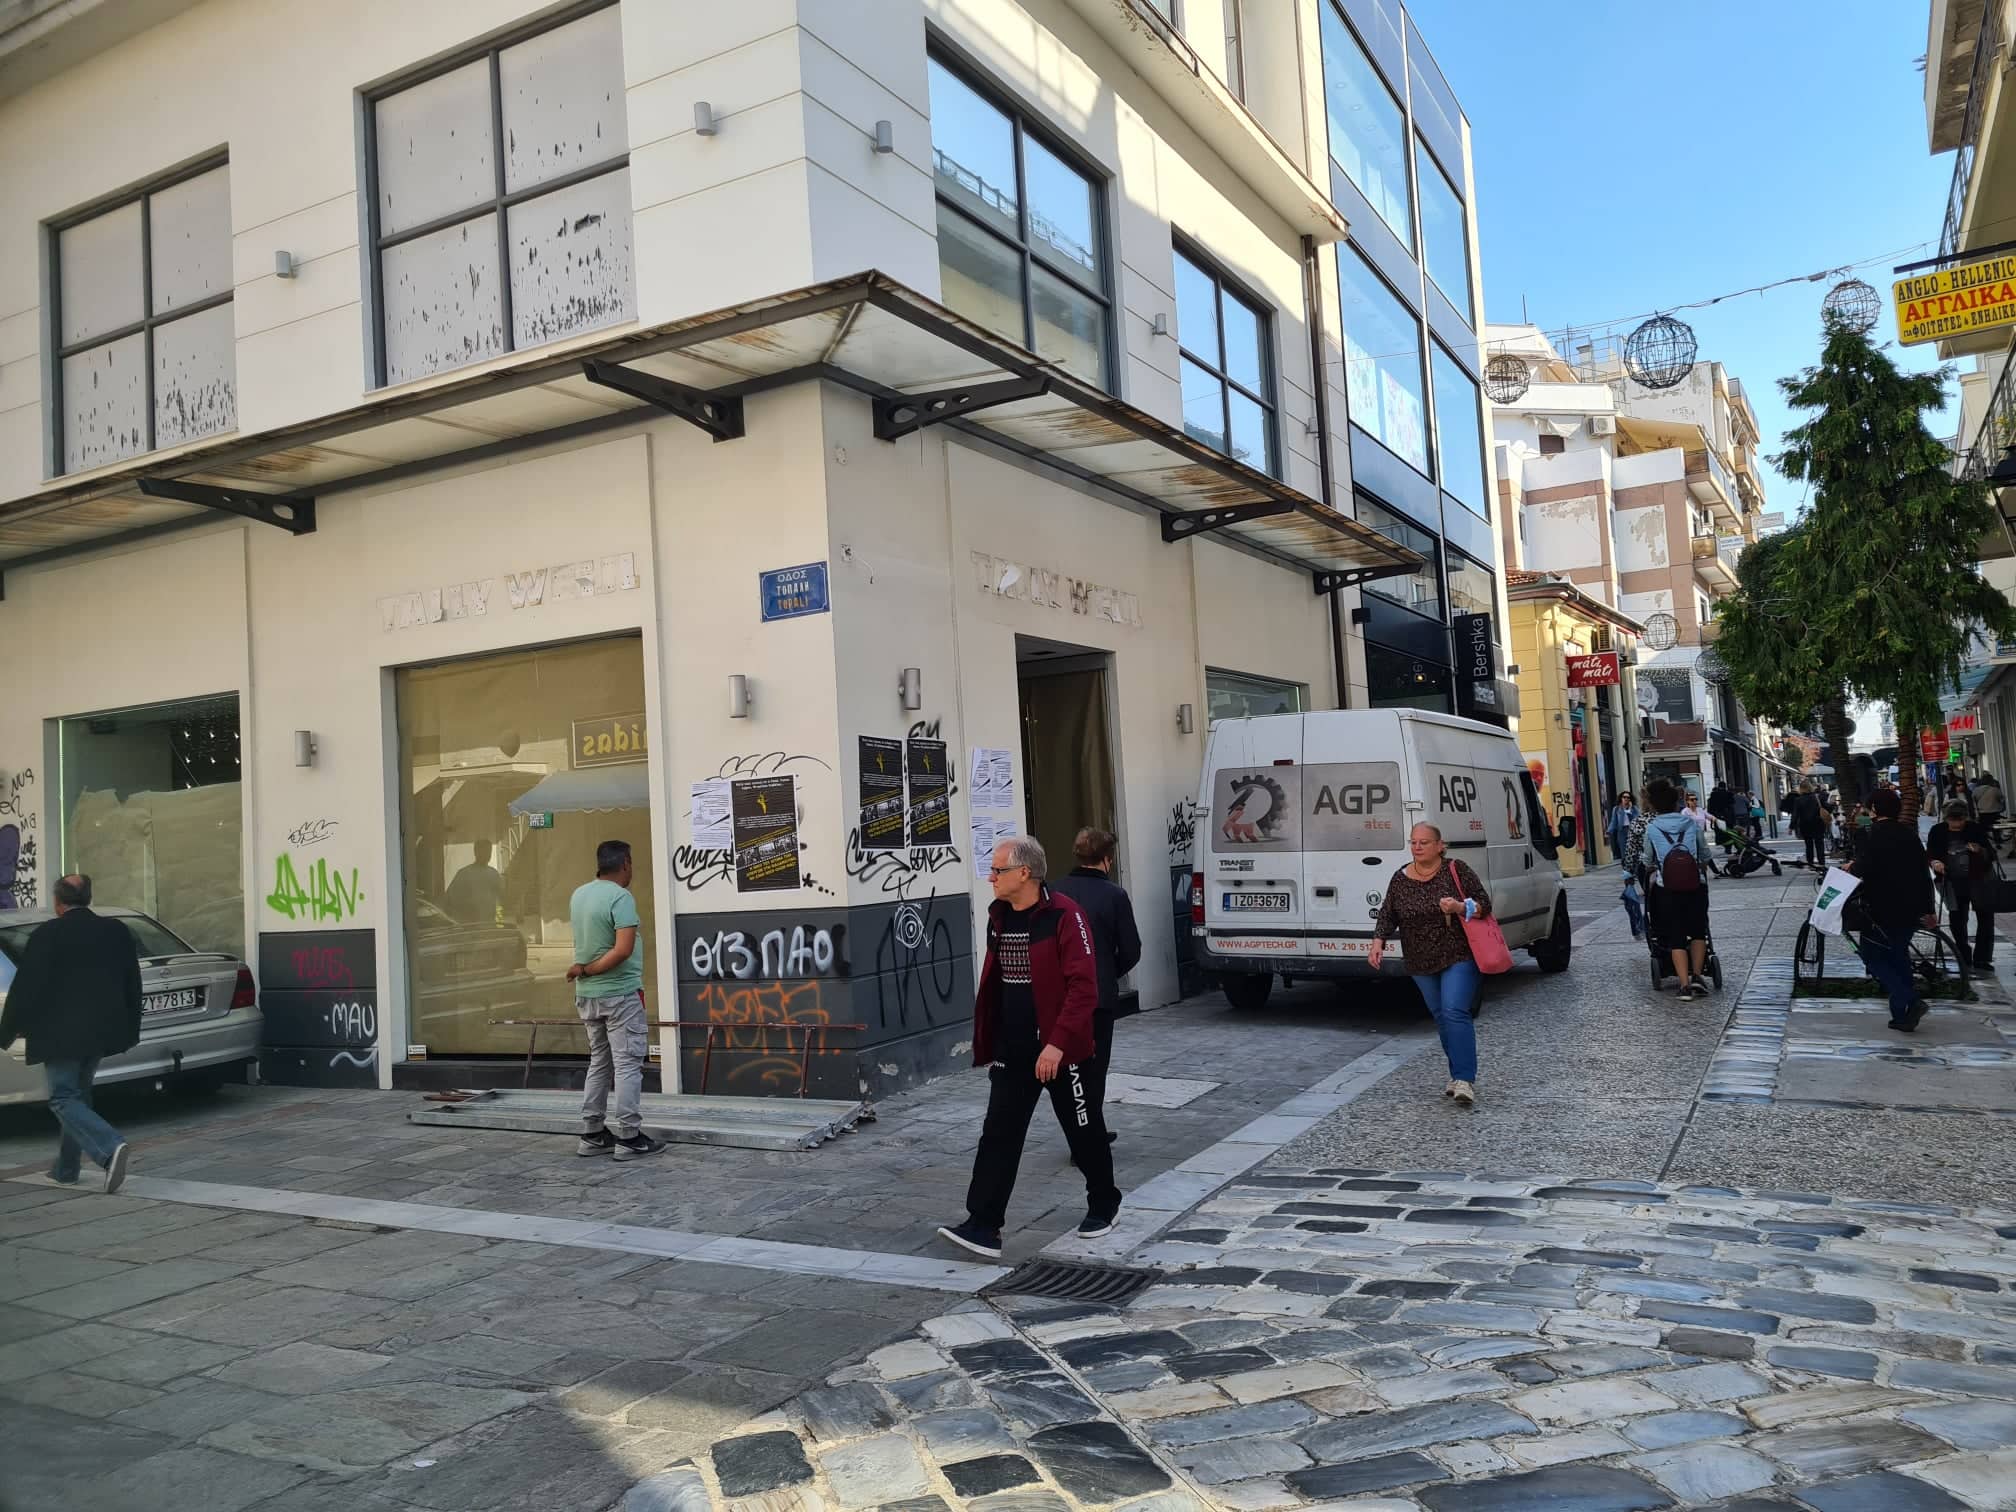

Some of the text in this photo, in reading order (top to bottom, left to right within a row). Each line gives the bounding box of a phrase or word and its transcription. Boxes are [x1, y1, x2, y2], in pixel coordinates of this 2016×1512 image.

[1898, 276, 1939, 301] ANGLO
[1950, 258, 2016, 289] HELLENIC
[1905, 282, 2016, 323] ΑΓΓΛΙΚΑ
[1912, 315, 1962, 338] ΦΟΙΤΗΤΕΣ
[776, 581, 809, 596] ΤΟΠΑΛΗ
[777, 570, 808, 583] ΟΔΟΣ
[1470, 618, 1488, 677] Bershka
[1313, 784, 1391, 815] AGP
[1439, 775, 1476, 812] AGP
[761, 926, 834, 979] ΠΑΟ
[1216, 940, 1297, 949] WWW.AGPTECH.GR
[1318, 942, 1336, 951] ΤΗΛ
[1342, 943, 1356, 951] 210
